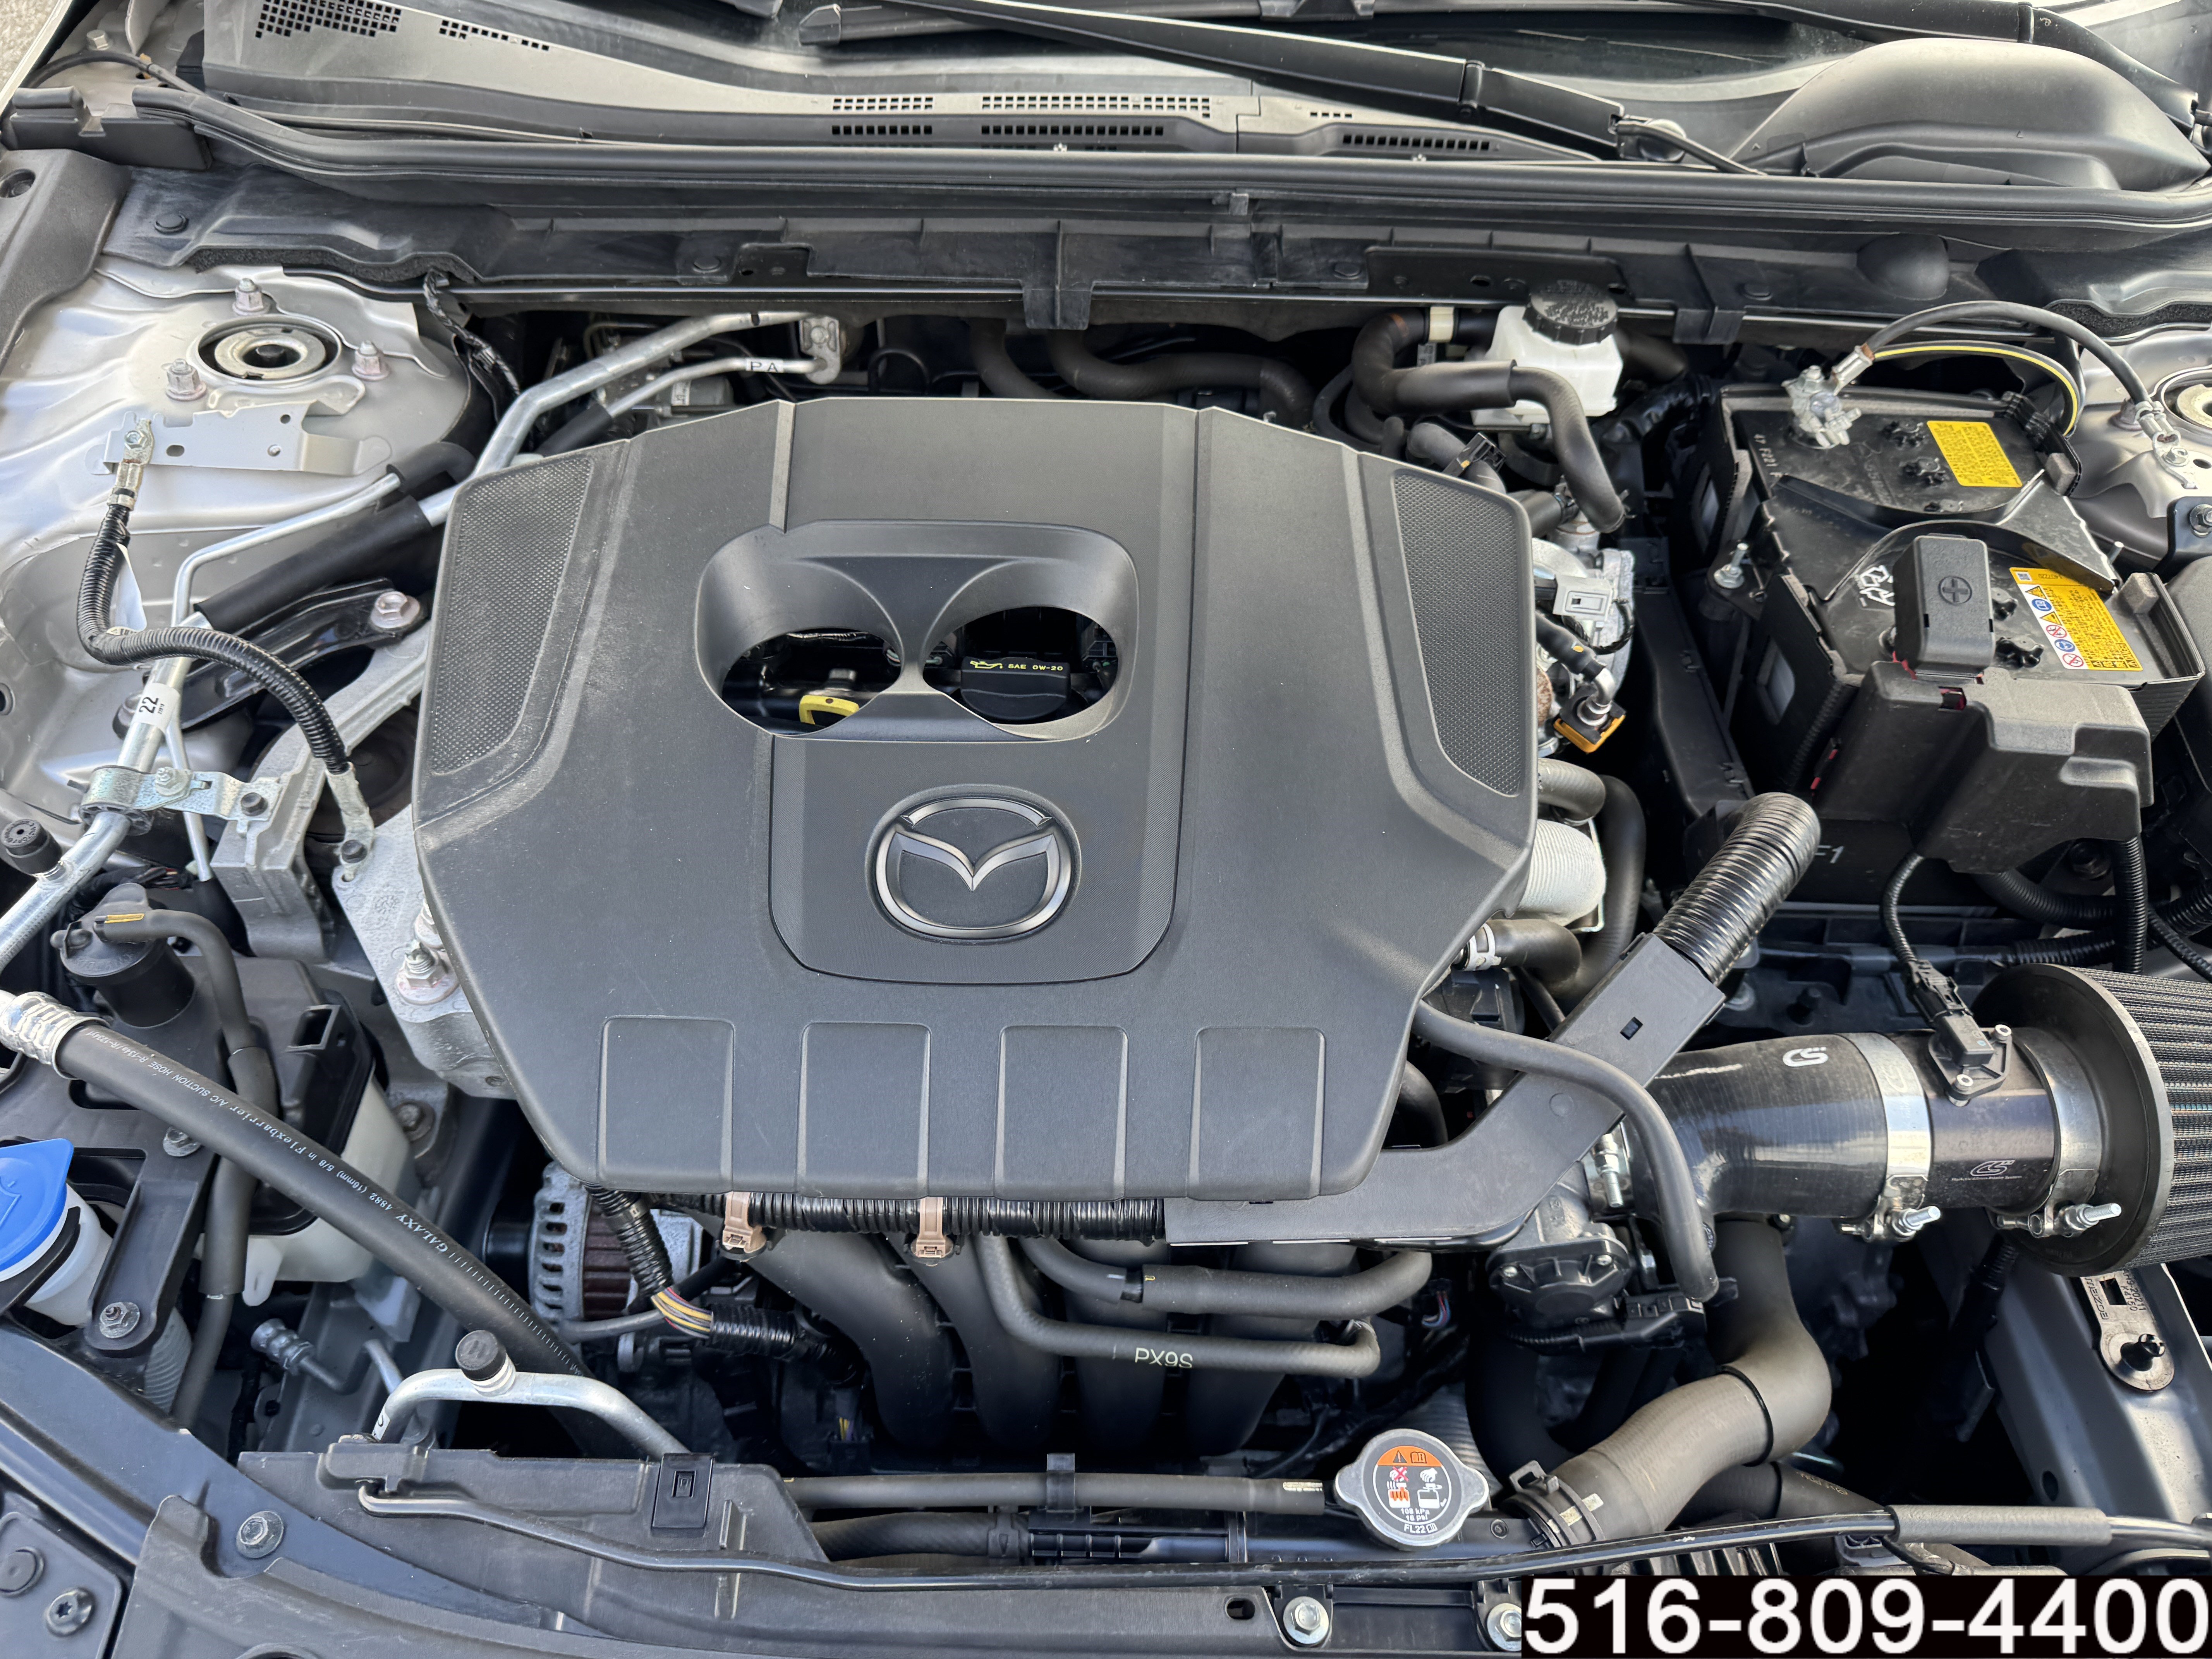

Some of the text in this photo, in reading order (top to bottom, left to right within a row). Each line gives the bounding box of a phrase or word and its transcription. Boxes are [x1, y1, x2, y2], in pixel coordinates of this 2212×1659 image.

[139, 697, 159, 713] 22
[149, 1060, 173, 1076] HOSE
[172, 1073, 210, 1096] SUCTION
[210, 1095, 228, 1106] A/C
[229, 1105, 306, 1154] Flexbarrier
[308, 1152, 317, 1160] in
[337, 1170, 367, 1193] (16mm)
[395, 1214, 448, 1252] GALAXY
[2121, 1286, 2138, 1311] K4150
[2123, 1269, 2147, 1311] H9-20211
[1135, 1347, 1193, 1368] PX9S
[1404, 1523, 1426, 1534] FL22
